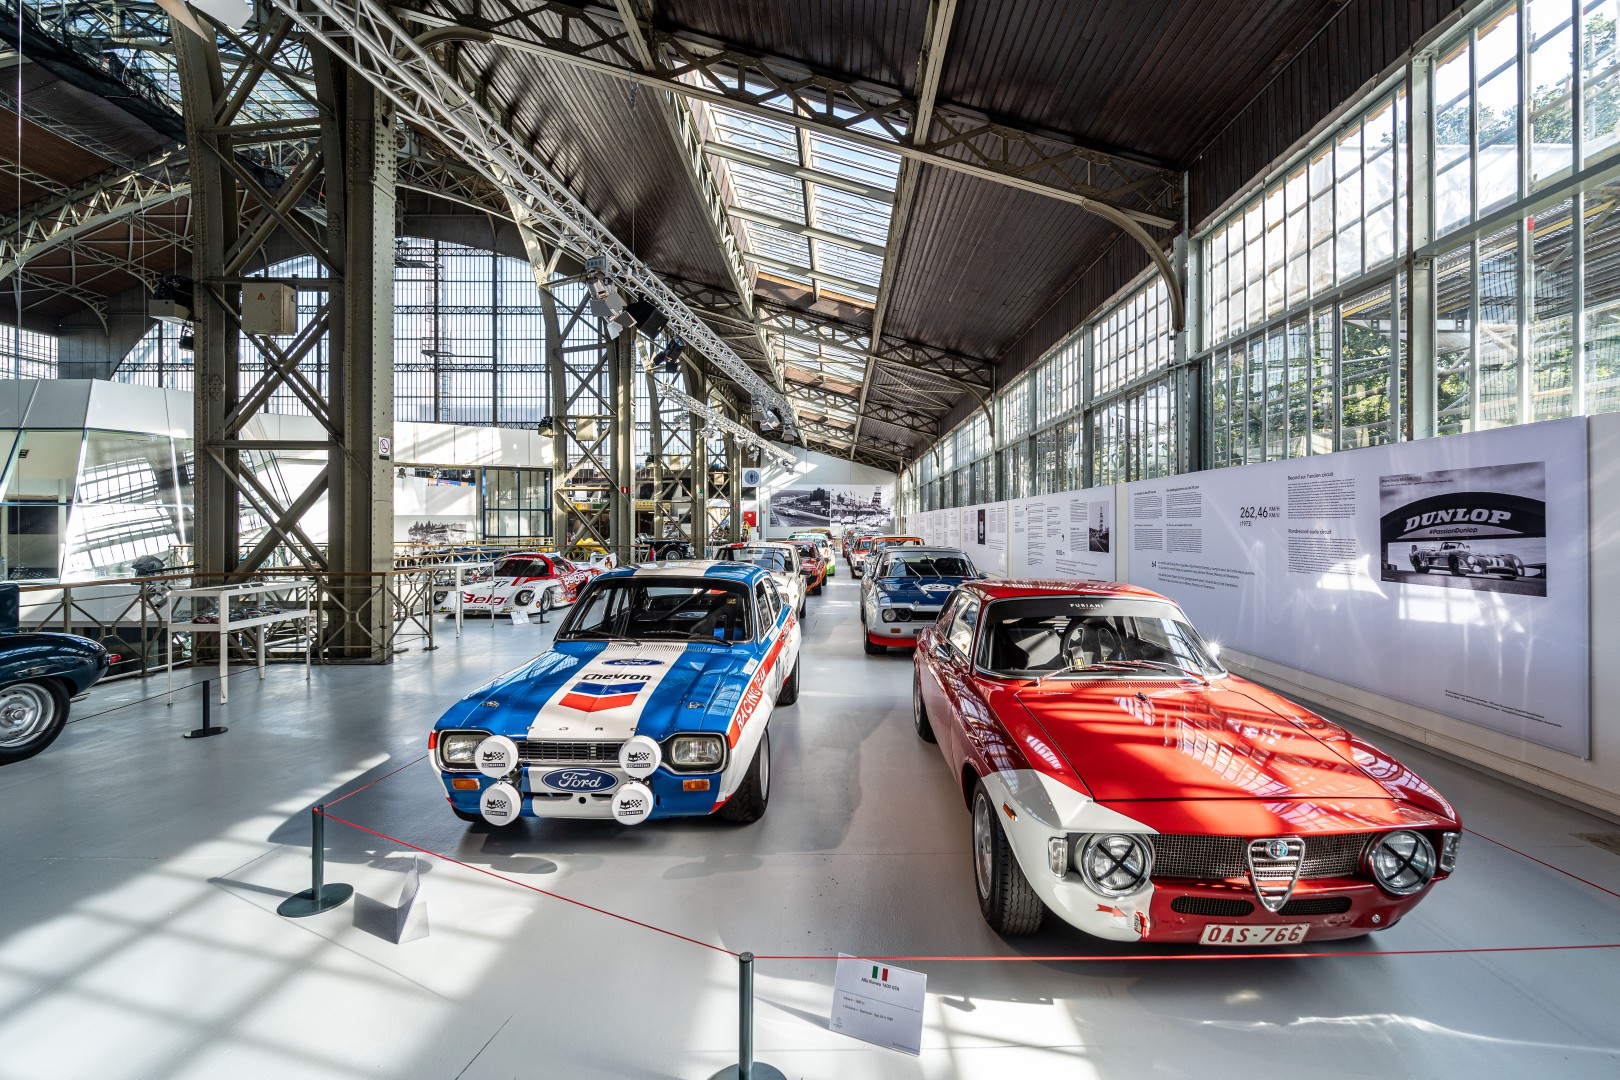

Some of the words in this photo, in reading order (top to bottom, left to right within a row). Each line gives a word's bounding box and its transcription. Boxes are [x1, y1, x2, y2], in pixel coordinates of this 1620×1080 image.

[1240, 506, 1268, 520] 262,46
[1403, 508, 1511, 533] DUNLOP
[1429, 526, 1478, 535] #PassionDunlop
[463, 591, 510, 606] Belg
[582, 673, 652, 681] Chevron
[735, 686, 761, 730] RACING
[558, 771, 602, 788] Ford
[1207, 926, 1303, 943] OAS-766
